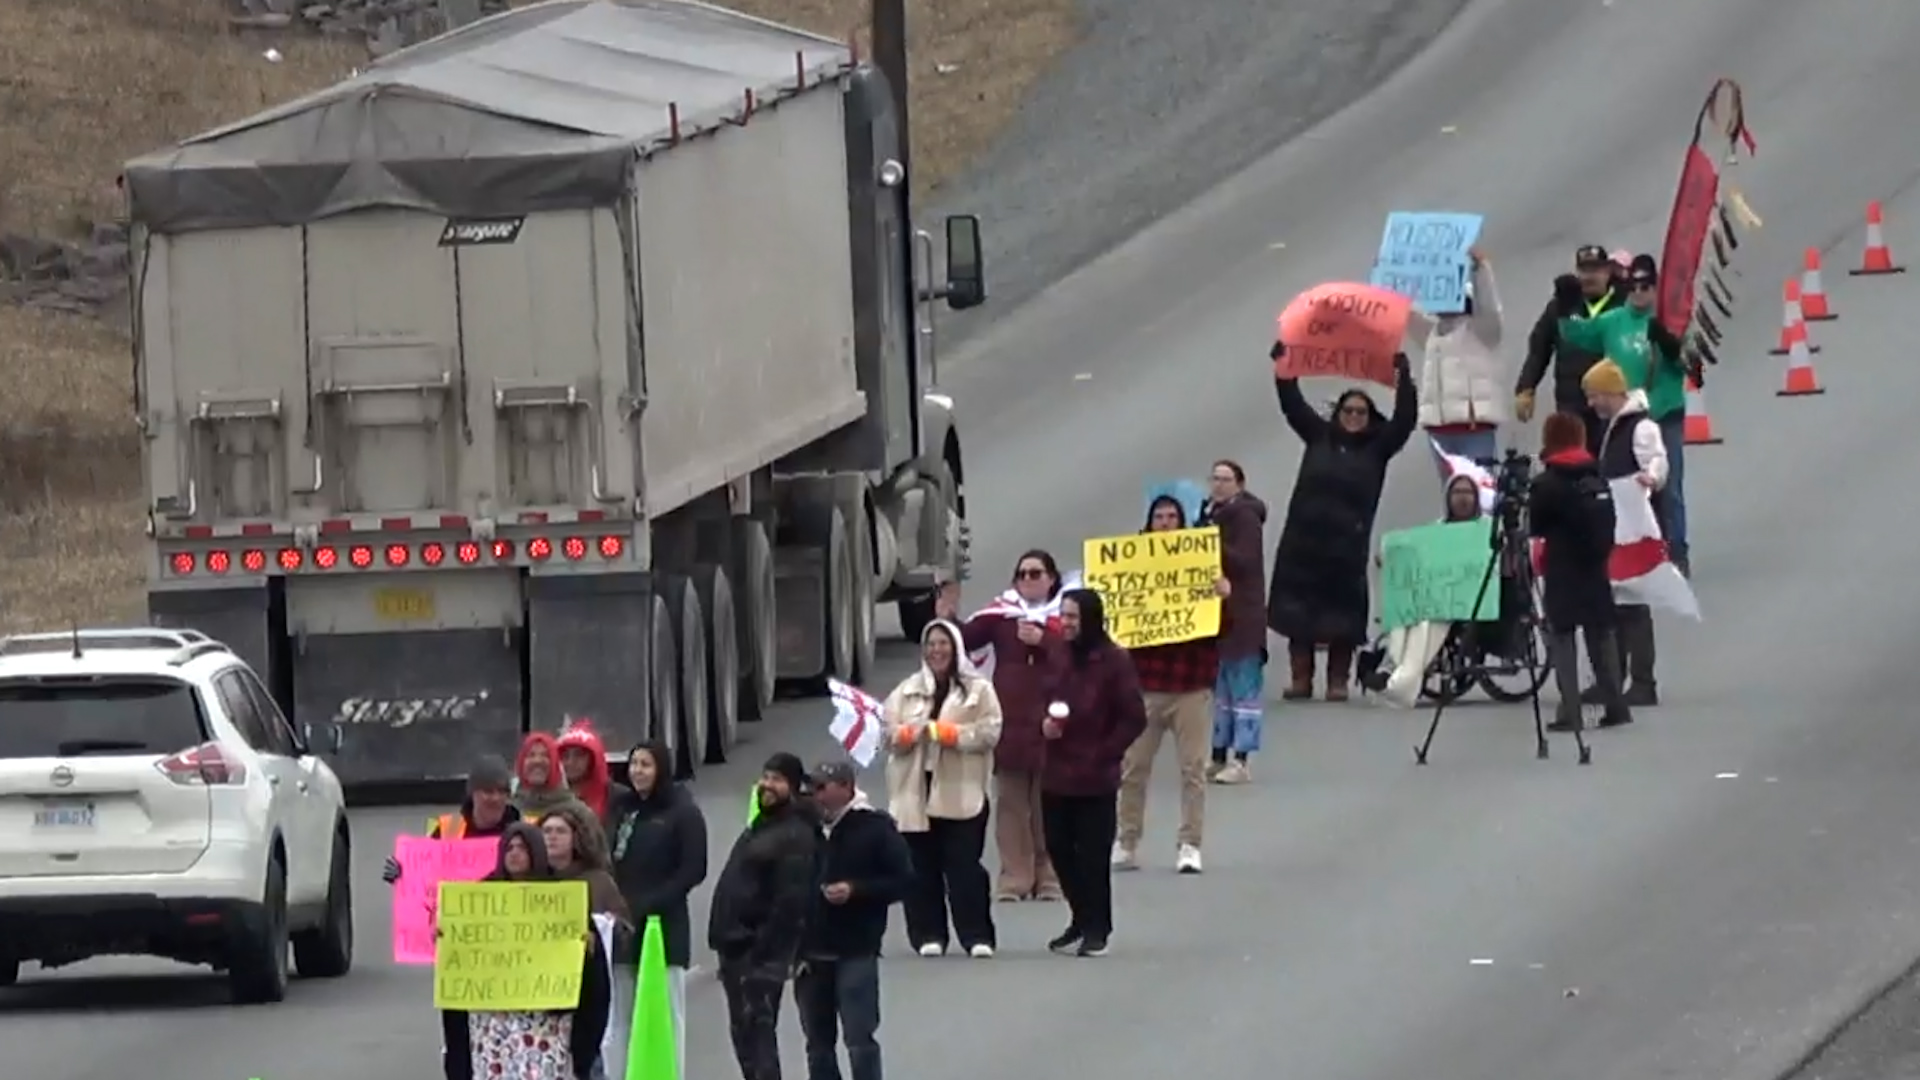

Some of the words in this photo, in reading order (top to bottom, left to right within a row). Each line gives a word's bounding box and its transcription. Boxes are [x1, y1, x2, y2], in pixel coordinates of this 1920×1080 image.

[1100, 541, 1136, 564] NO
[1149, 537, 1155, 557] I
[1162, 533, 1219, 556] WONT
[1155, 569, 1178, 586] ON
[1185, 565, 1219, 584] THE
[1127, 606, 1196, 628] TREATY
[332, 695, 477, 728] Stargate
[442, 888, 510, 917] LITTLE
[450, 921, 504, 944] NEEDS
[513, 921, 533, 942] TO
[445, 950, 462, 971] A
[440, 976, 496, 1002] LEAVE
